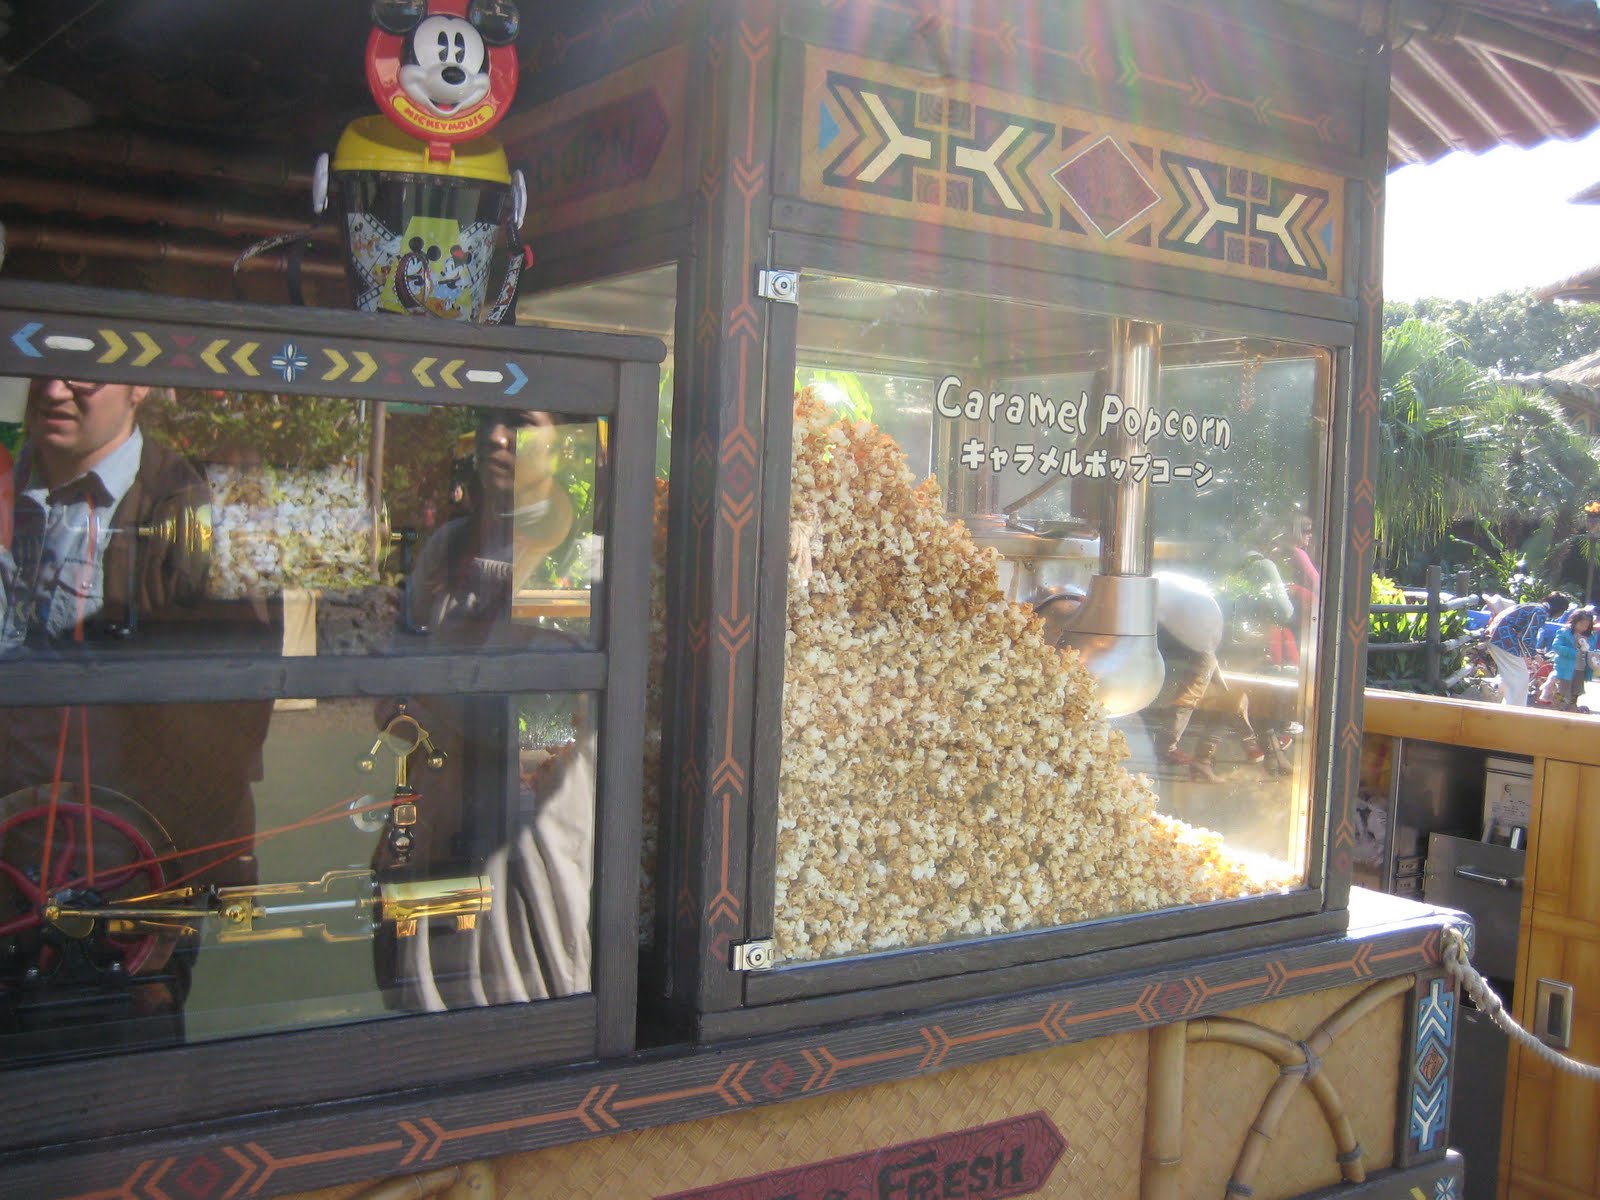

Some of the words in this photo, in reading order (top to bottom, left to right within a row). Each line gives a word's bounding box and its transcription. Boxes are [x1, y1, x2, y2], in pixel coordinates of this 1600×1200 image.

[936, 375, 1089, 435] Caramel
[1099, 393, 1232, 450] Popcorn
[960, 438, 1214, 487] キャラメルポップコーン
[877, 1143, 1026, 1200] FRESH
